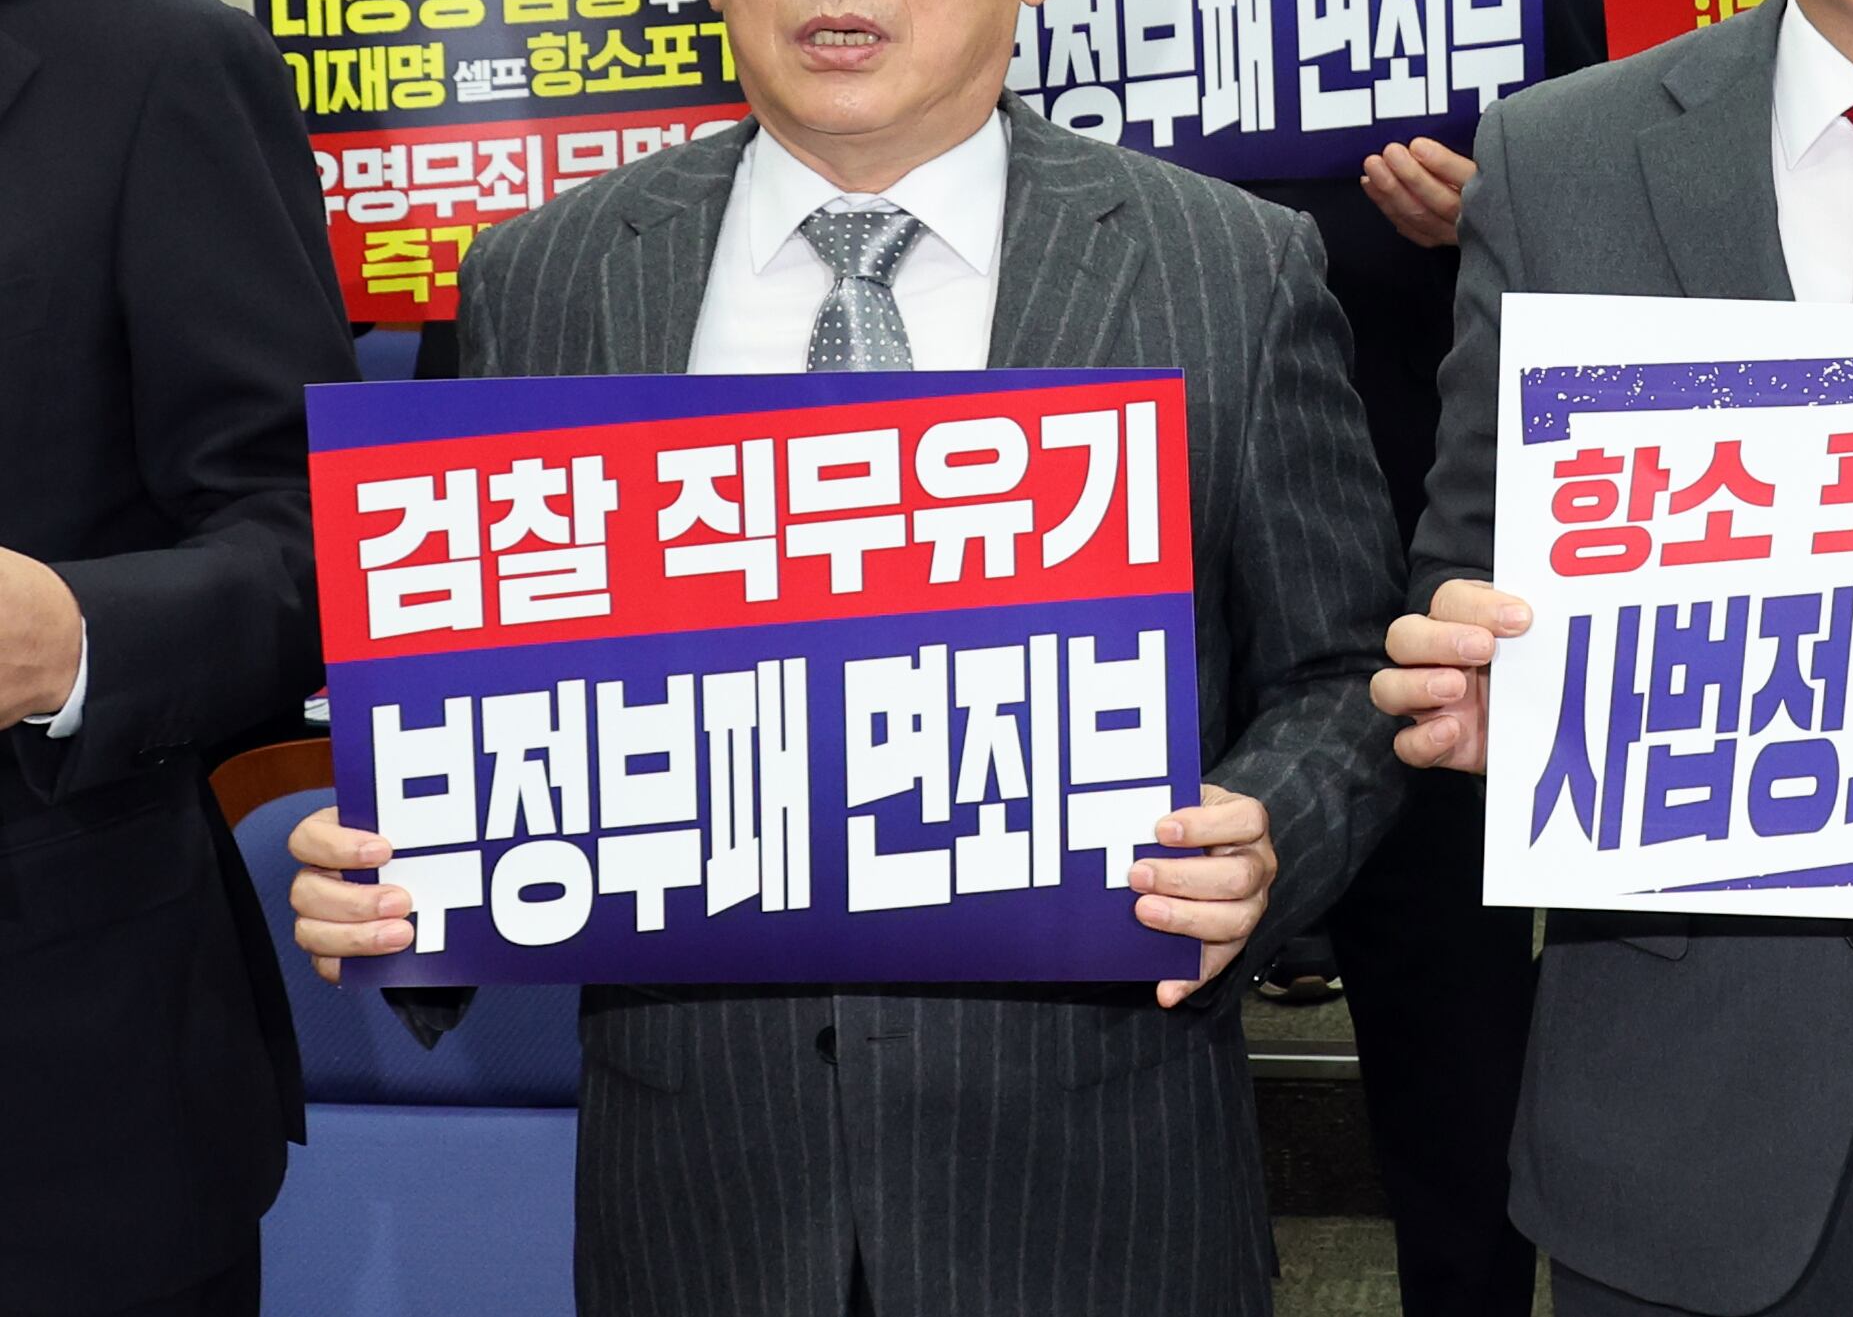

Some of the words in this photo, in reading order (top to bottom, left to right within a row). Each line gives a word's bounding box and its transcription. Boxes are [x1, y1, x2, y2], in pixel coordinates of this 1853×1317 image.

[452, 57, 530, 103] 셀프
[355, 456, 618, 640] 검찰
[656, 399, 1162, 604] 직무유기
[1548, 439, 1775, 579] 항소
[371, 656, 812, 955] 부정부패
[843, 628, 1173, 915] 면죄부
